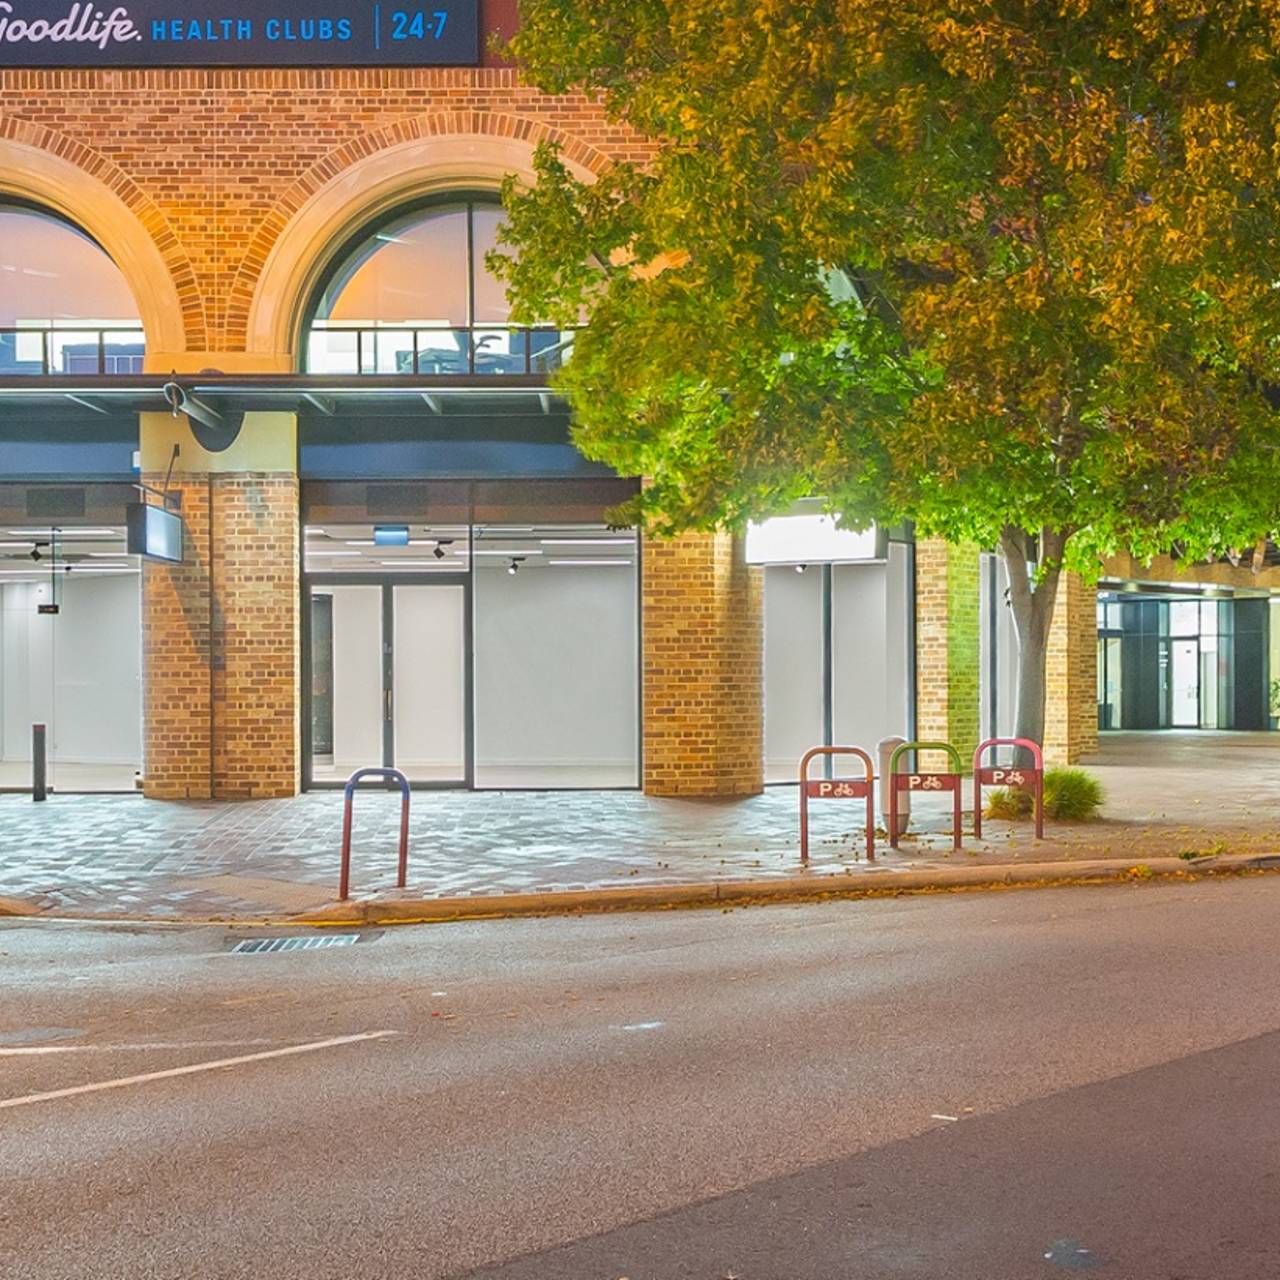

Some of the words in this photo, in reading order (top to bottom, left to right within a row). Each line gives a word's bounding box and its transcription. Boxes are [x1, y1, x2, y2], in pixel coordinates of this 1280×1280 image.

[152, 19, 252, 40] HEALTH
[266, 18, 352, 41] CLUBS
[908, 776, 921, 789] P
[992, 770, 1005, 783] P
[819, 783, 832, 796] P
